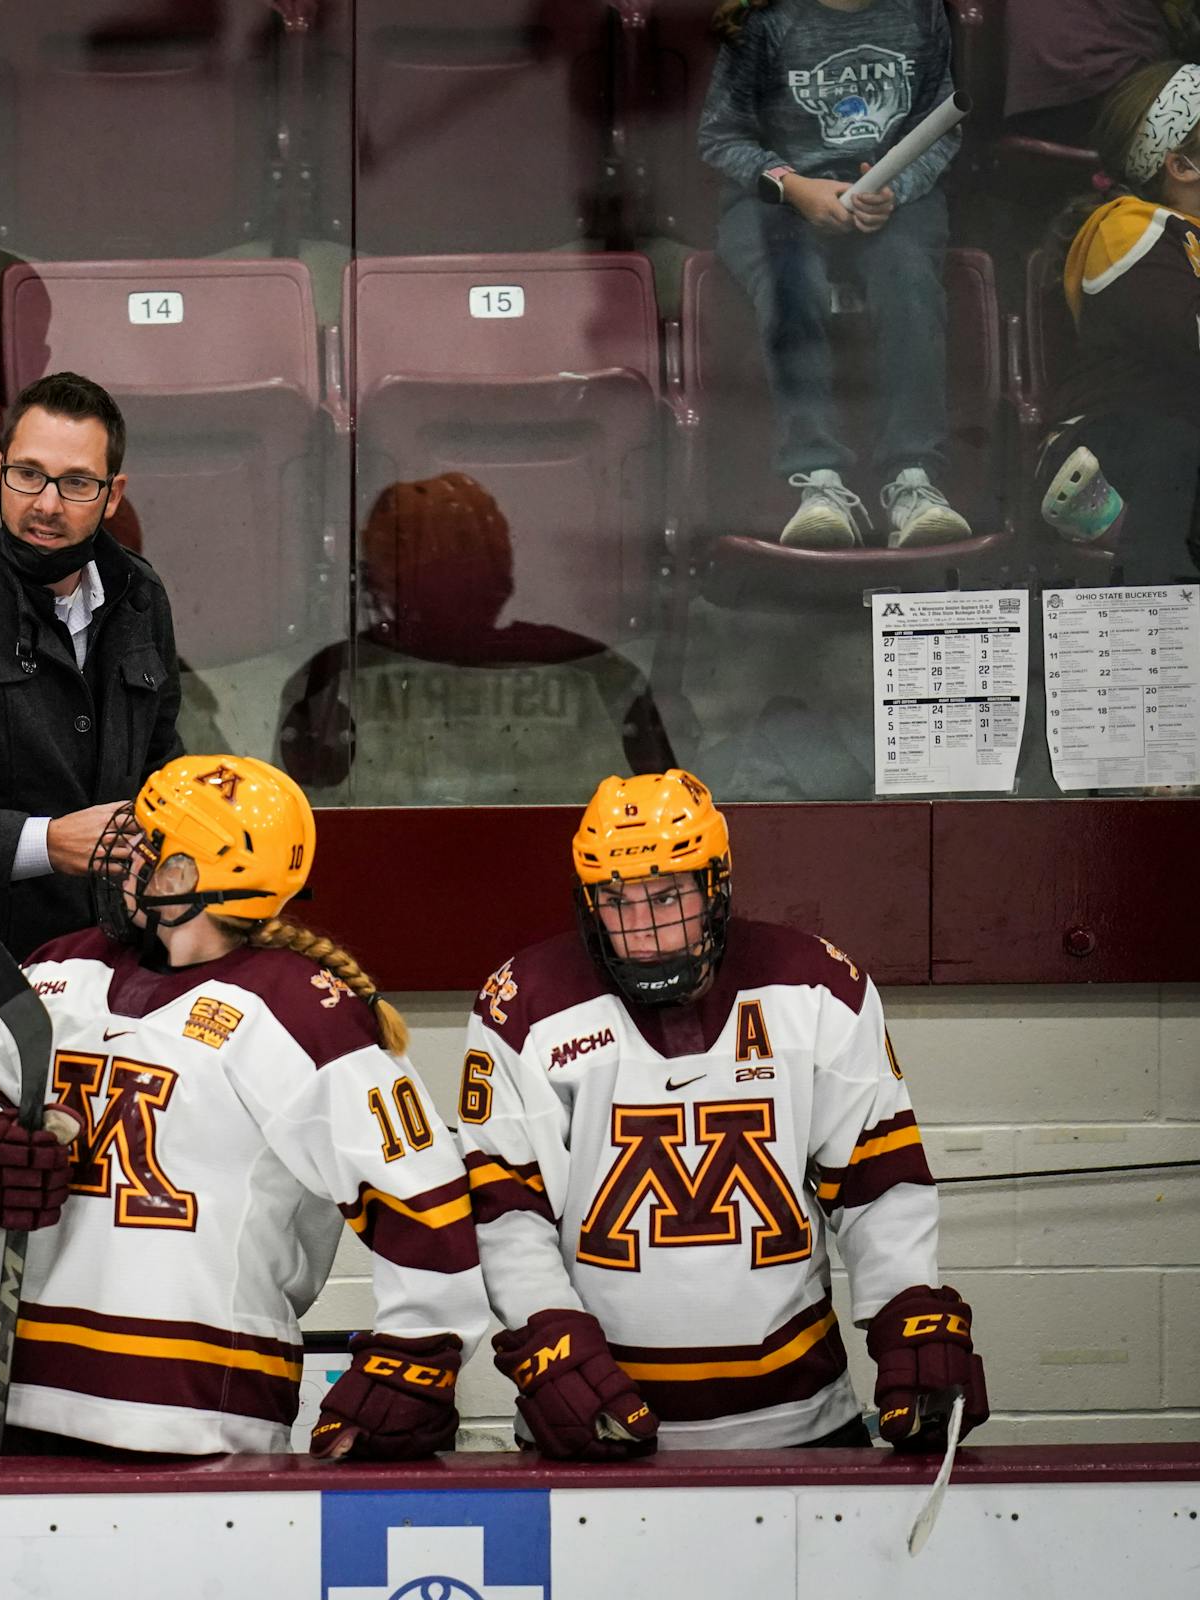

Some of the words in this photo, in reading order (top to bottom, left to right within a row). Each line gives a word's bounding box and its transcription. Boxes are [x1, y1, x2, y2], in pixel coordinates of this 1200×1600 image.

[788, 60, 915, 86] BLAINE
[482, 291, 513, 312] 15
[140, 298, 172, 319] 14
[1076, 593, 1097, 601] OHIO
[1099, 592, 1123, 600] STATE
[1125, 590, 1168, 599] BUCKEYES
[884, 638, 894, 646] 27
[934, 637, 940, 645] 9
[980, 634, 989, 644] 15
[884, 653, 895, 662] 20
[933, 652, 942, 660] 16
[982, 650, 987, 659] 3
[887, 668, 893, 678] 4
[978, 666, 990, 674] 22
[886, 684, 894, 692] 11
[934, 682, 942, 691] 17
[982, 680, 988, 690] 8
[888, 706, 894, 716] 2
[932, 705, 943, 714] 24
[979, 704, 990, 713] 35
[888, 722, 894, 730] 5
[934, 720, 943, 730] 13
[980, 718, 989, 728] 31
[888, 736, 896, 746] 14
[984, 734, 987, 742] 1
[888, 752, 896, 760] 10
[608, 843, 657, 858] CCM
[287, 844, 305, 871] 10
[636, 975, 679, 991] CCM
[31, 980, 68, 997] CHA
[735, 1000, 774, 1062] A
[556, 1028, 616, 1068] WCHA
[735, 1066, 775, 1083] 25
[457, 1049, 495, 1125] 6
[368, 1076, 434, 1164] 10
[576, 1098, 812, 1272] M
[313, 1421, 342, 1439] CCM
